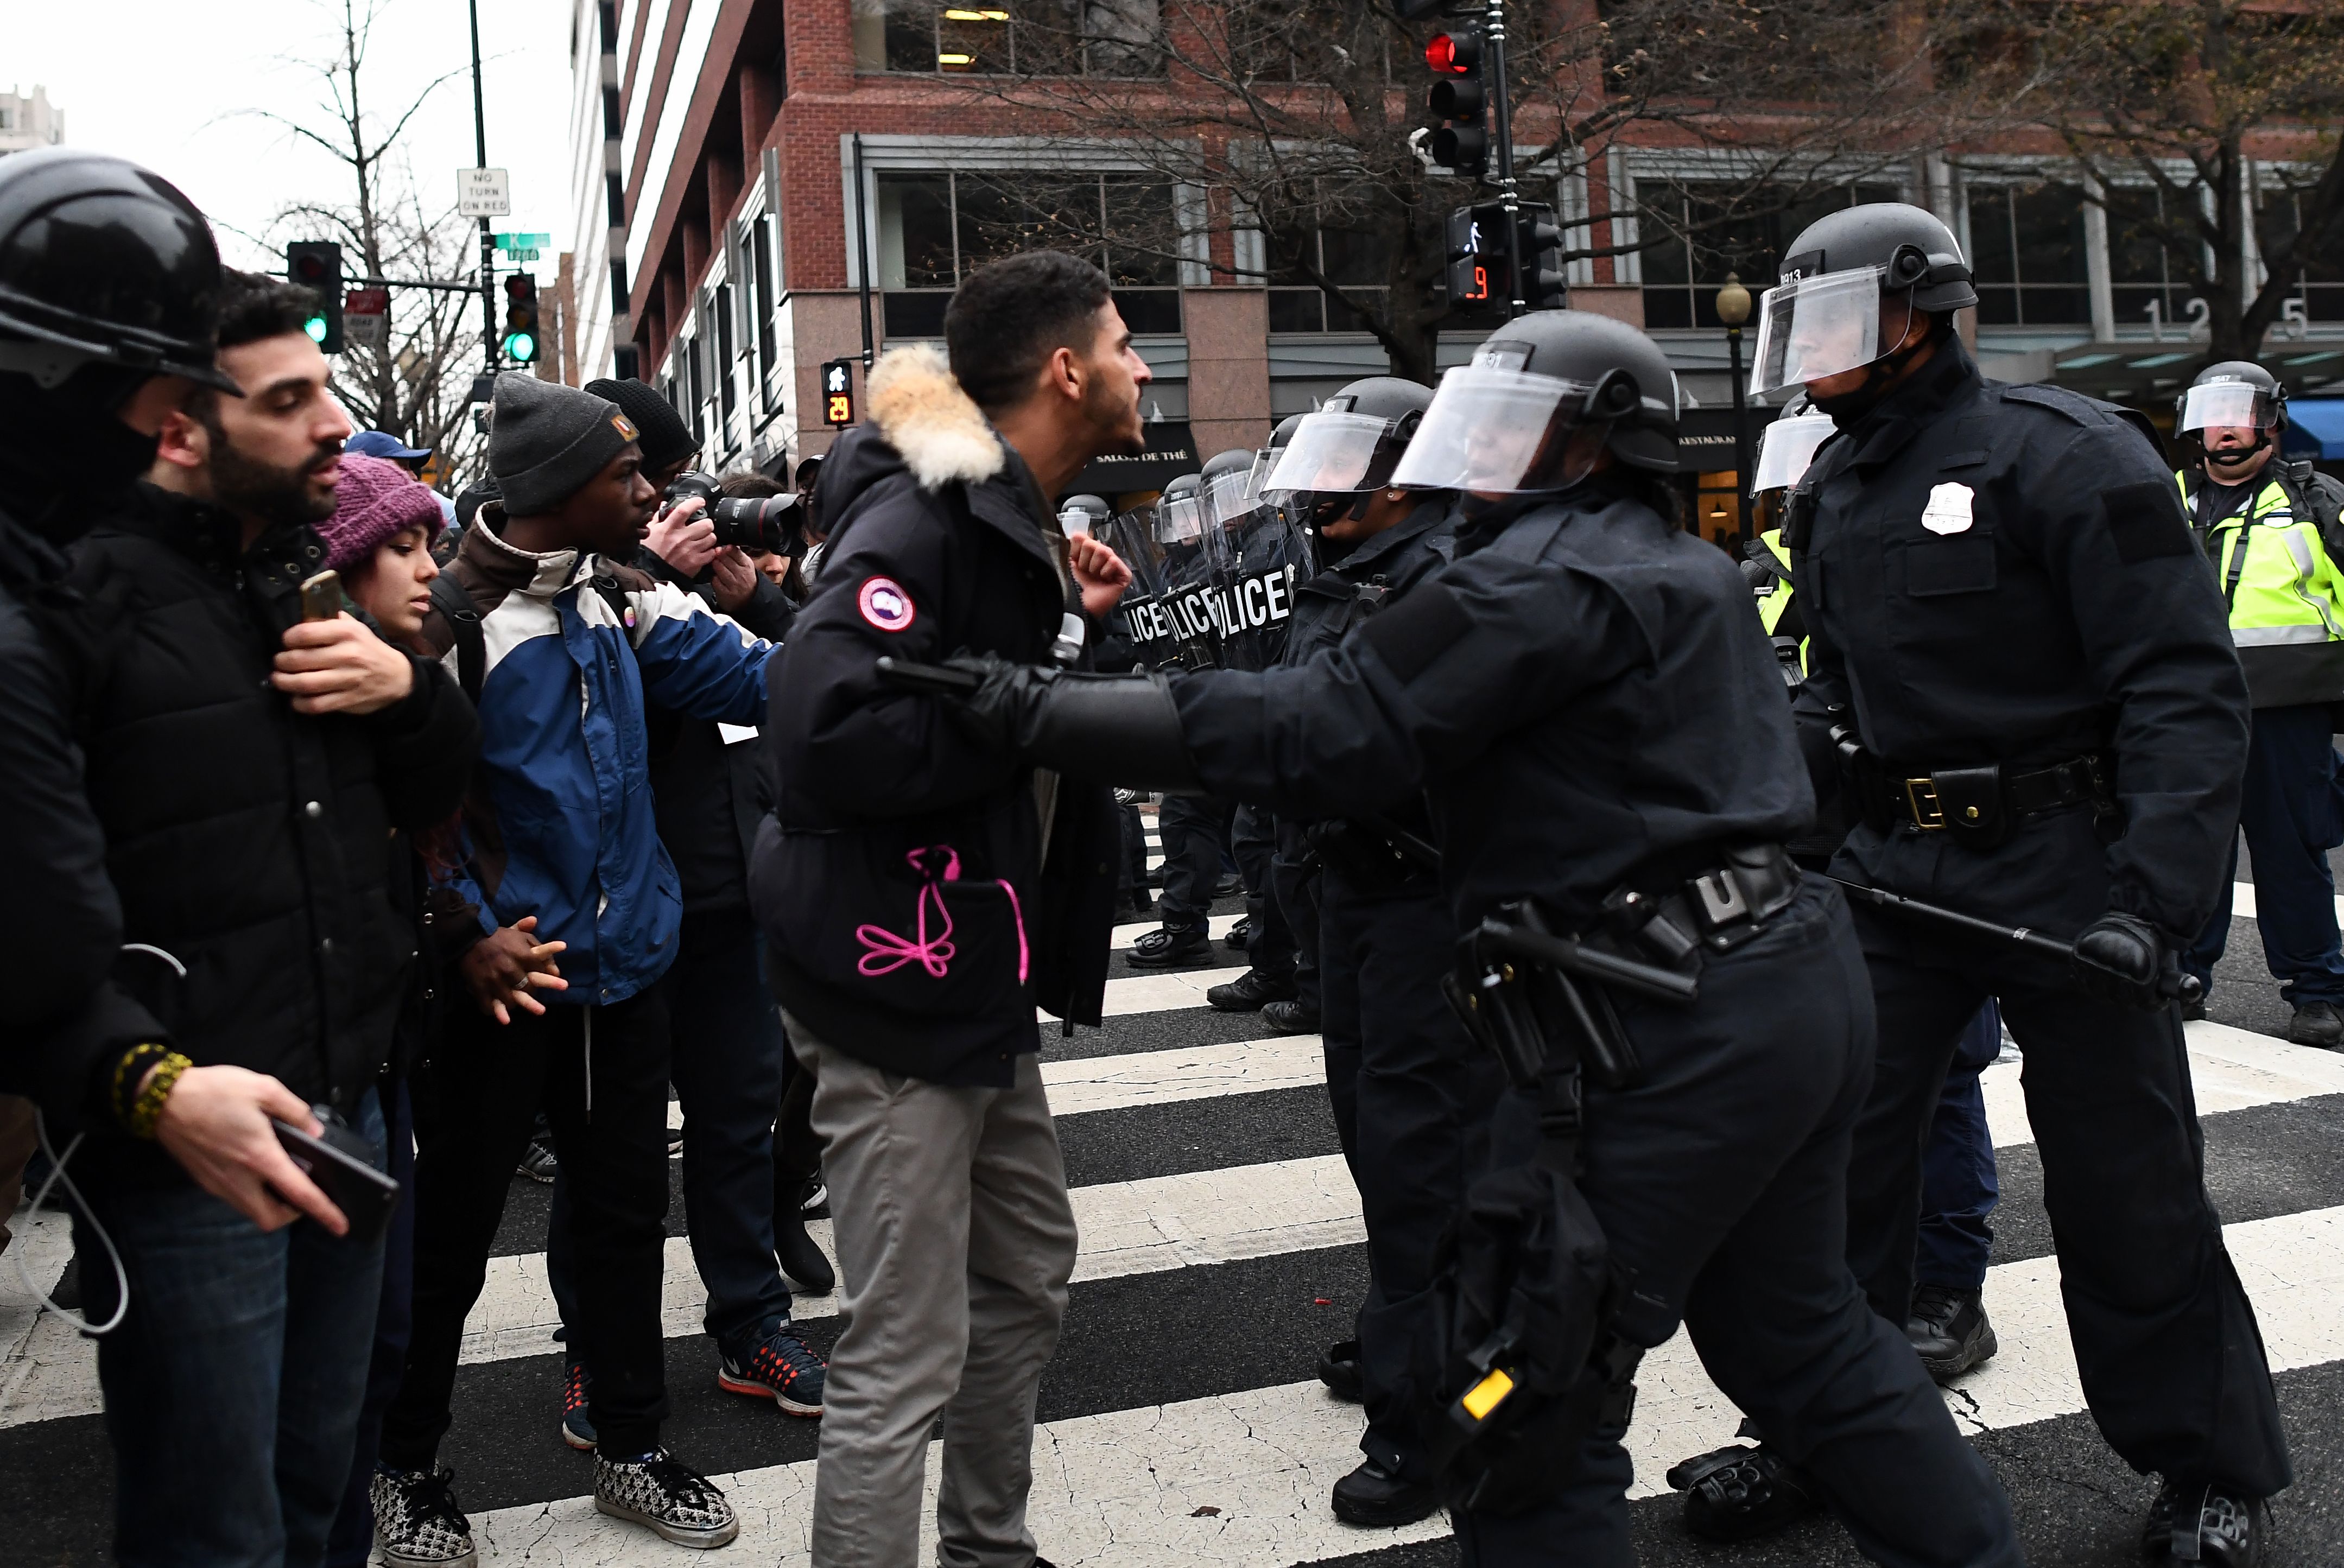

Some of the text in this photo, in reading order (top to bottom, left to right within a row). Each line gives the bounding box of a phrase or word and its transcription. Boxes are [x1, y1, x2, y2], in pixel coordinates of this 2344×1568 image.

[474, 174, 491, 182] NO
[470, 187, 498, 195] TURN
[485, 201, 506, 210] RED
[2143, 297, 2308, 342] 125
[829, 397, 848, 421] 29
[1141, 452, 1159, 461] DE
[1214, 570, 1289, 639] OLICE
[1124, 602, 1168, 643] LICE
